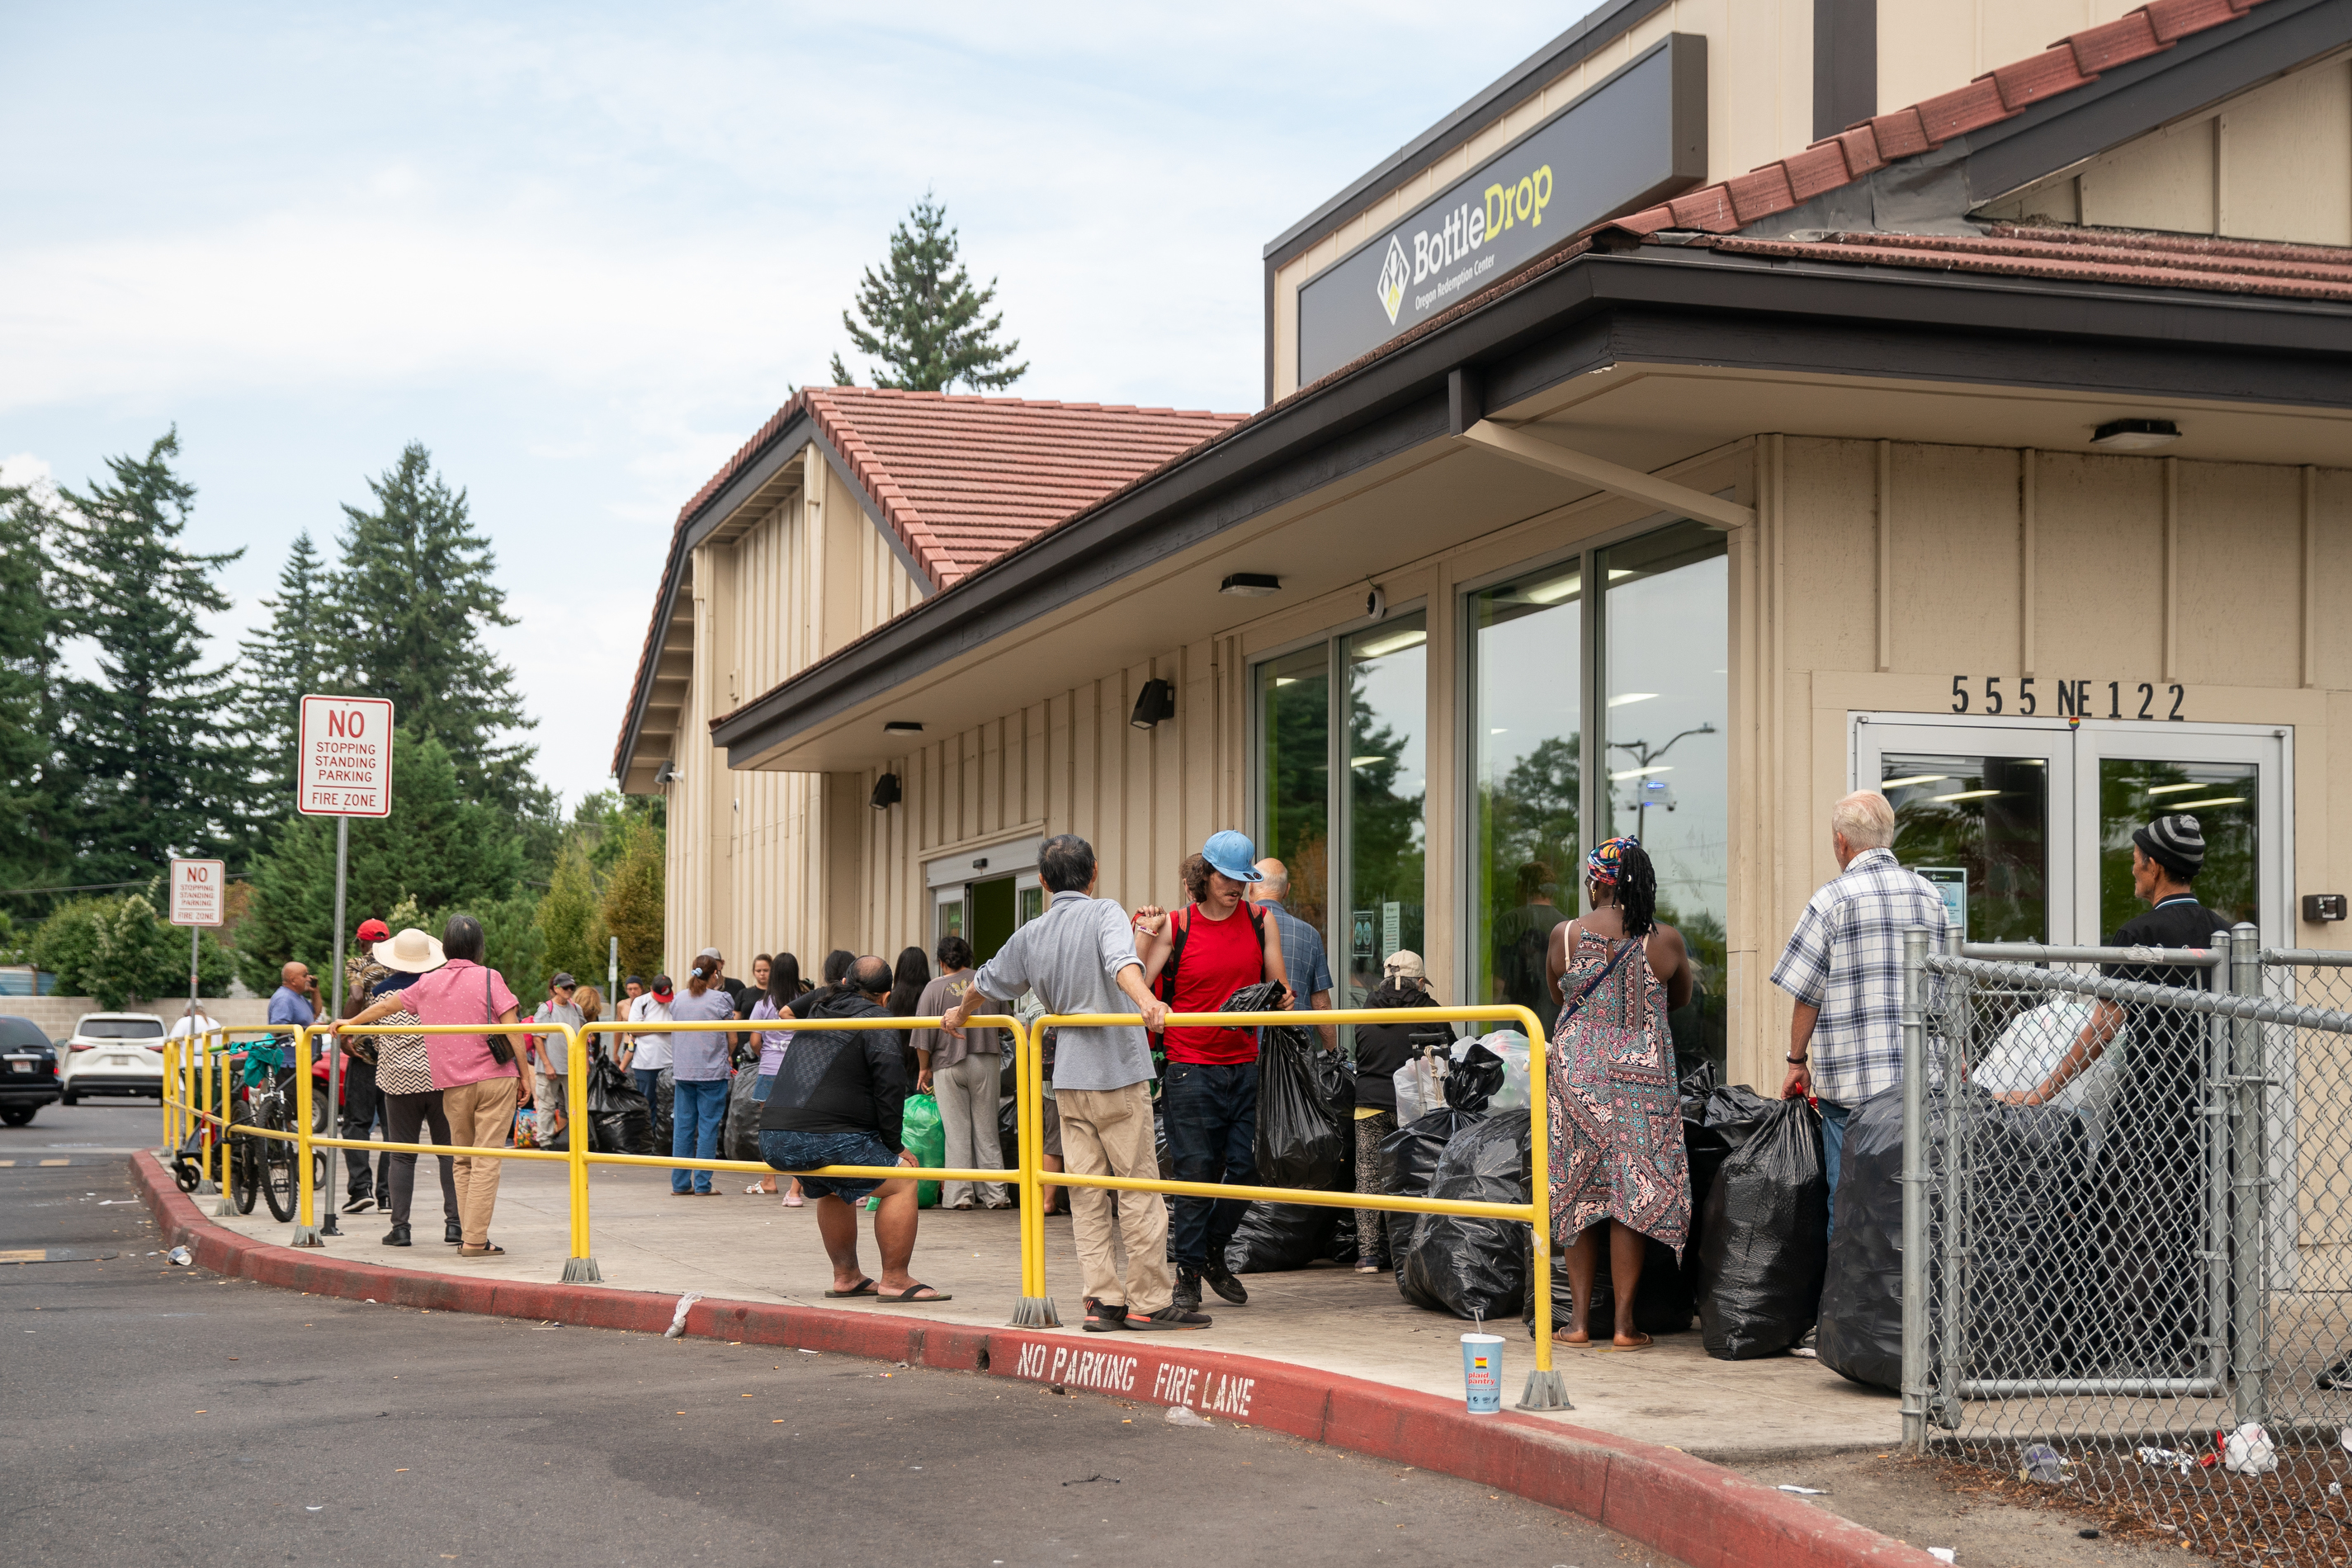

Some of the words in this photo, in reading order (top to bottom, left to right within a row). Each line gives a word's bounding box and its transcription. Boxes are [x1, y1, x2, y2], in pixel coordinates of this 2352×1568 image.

[1414, 164, 1553, 286] BottleDrop
[1415, 289, 1437, 311] Oregon
[1437, 267, 1473, 291] Redemption
[1474, 253, 1495, 276] Center
[2058, 679, 2092, 717] NE
[2108, 681, 2184, 720] 122
[328, 710, 365, 739] NO
[316, 742, 376, 755] STOPPING
[315, 755, 376, 768] STANDING
[319, 769, 373, 782] PARKING
[312, 792, 338, 805] FIRE
[344, 793, 376, 807] ZONE
[187, 867, 208, 883] NO
[196, 912, 214, 920] ZONE
[1017, 1342, 1047, 1378] NO
[1050, 1347, 1137, 1391] PARKING
[1153, 1363, 1199, 1405] FIRE
[1201, 1372, 1255, 1416] LANE
